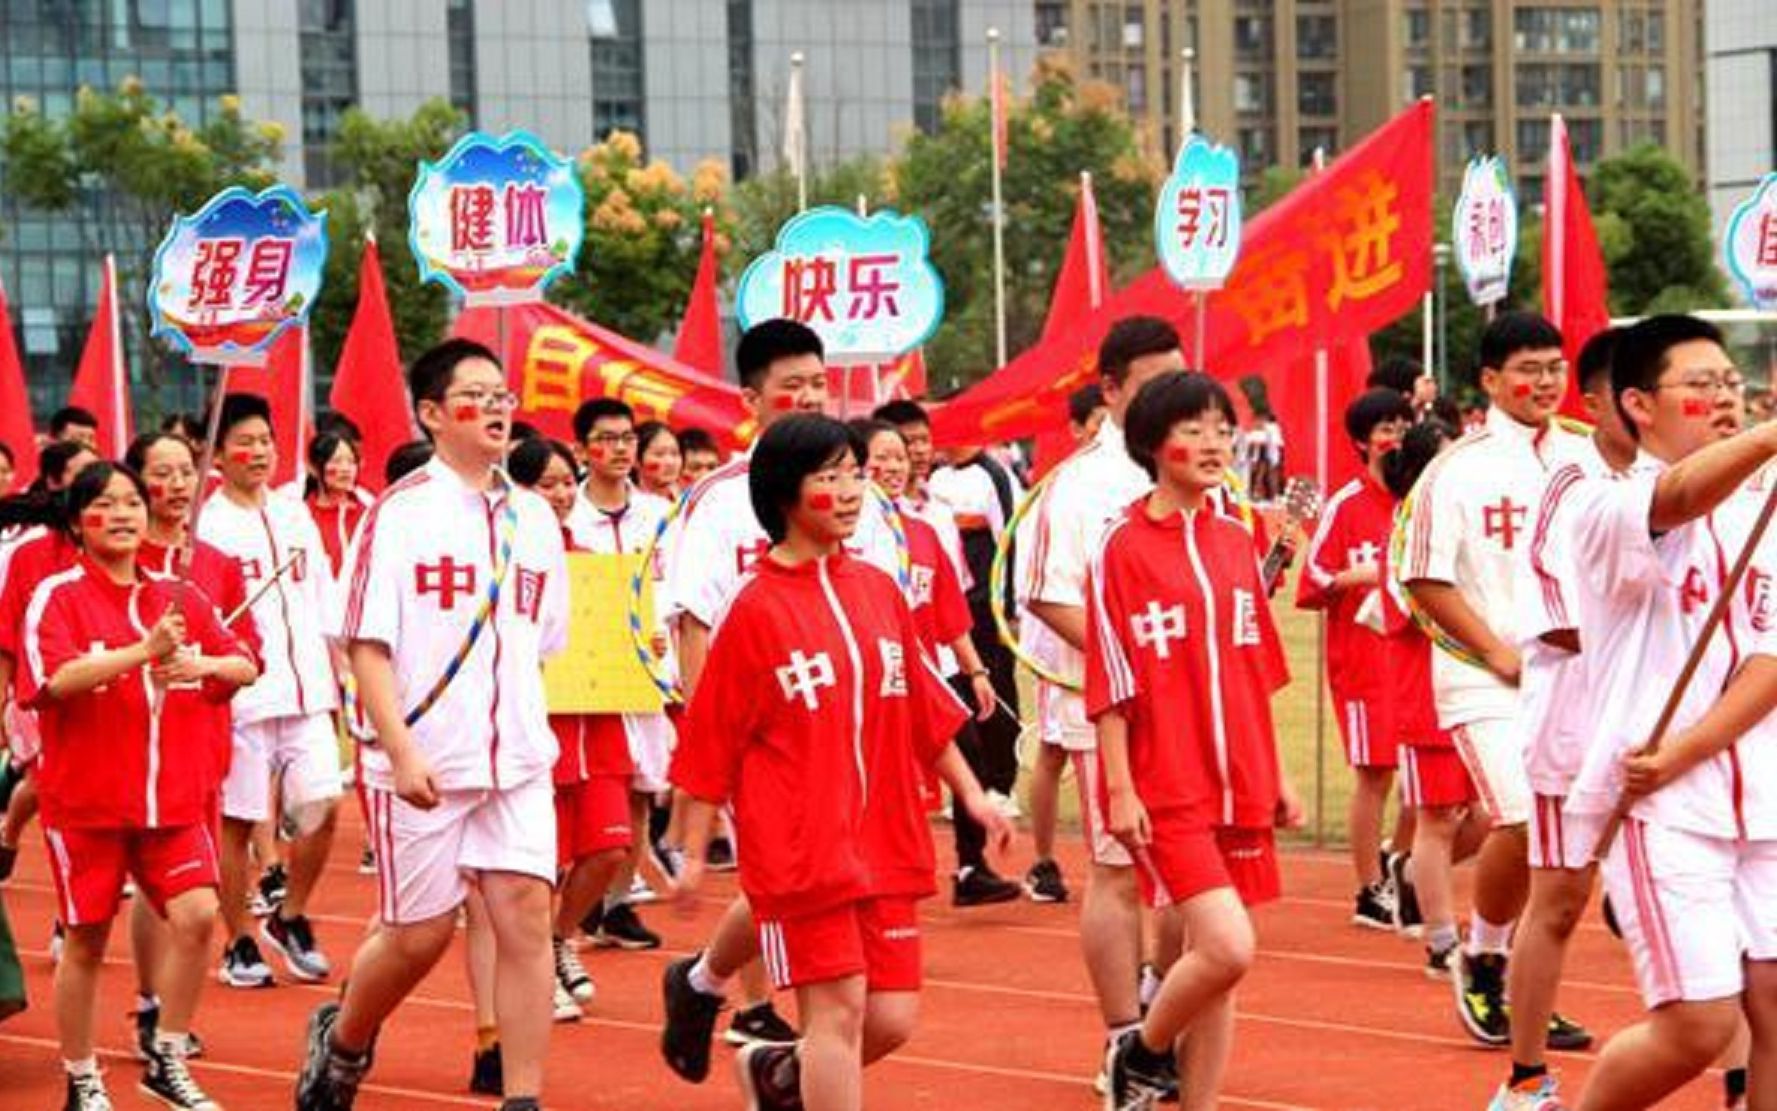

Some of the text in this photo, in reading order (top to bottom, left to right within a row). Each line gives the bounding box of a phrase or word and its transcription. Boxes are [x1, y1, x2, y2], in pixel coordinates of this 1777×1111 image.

[450, 184, 547, 251] 健体
[1177, 188, 1228, 248] 学习
[189, 239, 292, 307] 强身
[783, 255, 898, 322] 快乐
